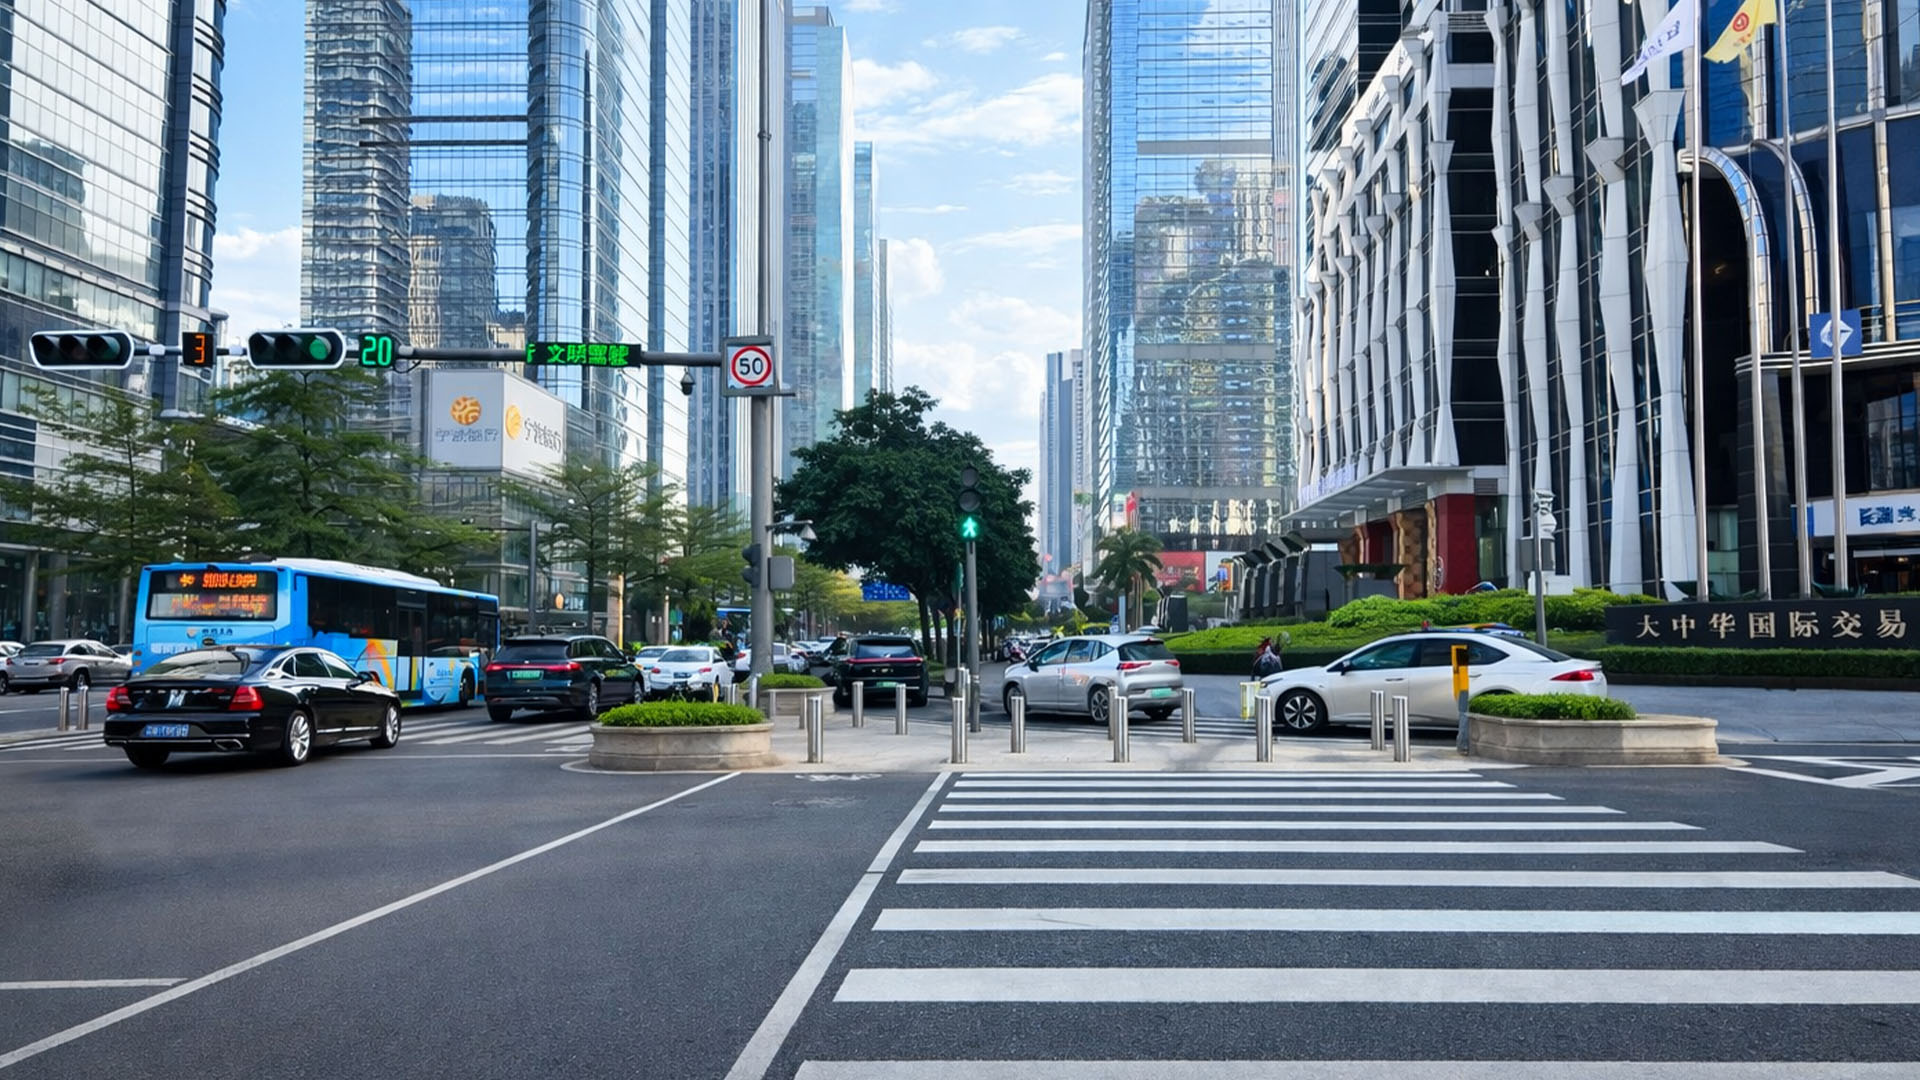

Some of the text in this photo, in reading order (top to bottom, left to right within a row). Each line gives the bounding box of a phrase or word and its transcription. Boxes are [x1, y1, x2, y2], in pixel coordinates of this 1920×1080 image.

[194, 335, 206, 364] 3
[361, 336, 392, 366] 20
[739, 357, 764, 375] 50
[1636, 609, 1907, 640] 大中华国际交易
